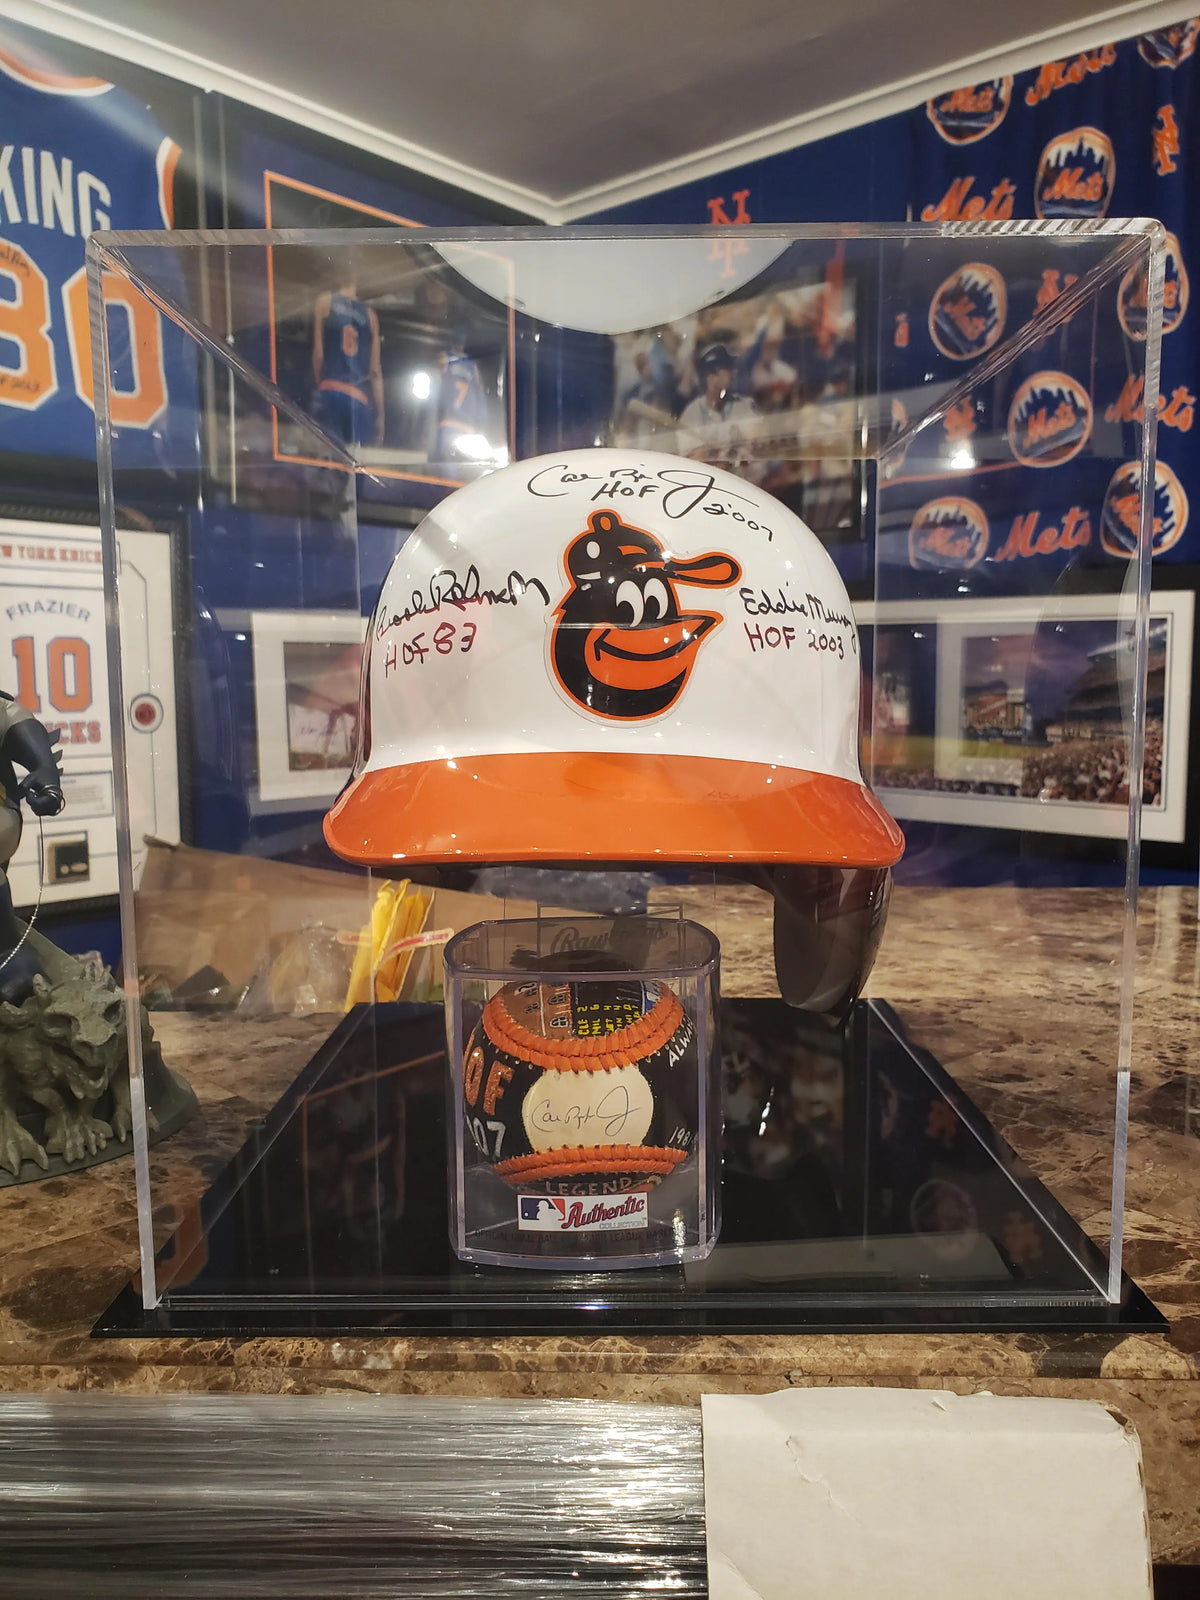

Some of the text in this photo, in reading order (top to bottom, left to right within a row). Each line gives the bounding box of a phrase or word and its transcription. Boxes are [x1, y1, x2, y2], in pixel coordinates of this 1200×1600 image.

[0, 145, 111, 239] KING
[921, 176, 1016, 222] Mets
[591, 481, 773, 542] HOF 2007
[991, 506, 1091, 561] Mets
[6, 600, 91, 621] FRAZIER
[739, 581, 808, 617] Eddie
[385, 622, 477, 678] HOF 83
[743, 622, 845, 660] HOF 2003
[12, 636, 93, 713] 10
[561, 1196, 646, 1230] Authentic
[599, 1218, 646, 1230] COLLECTION
